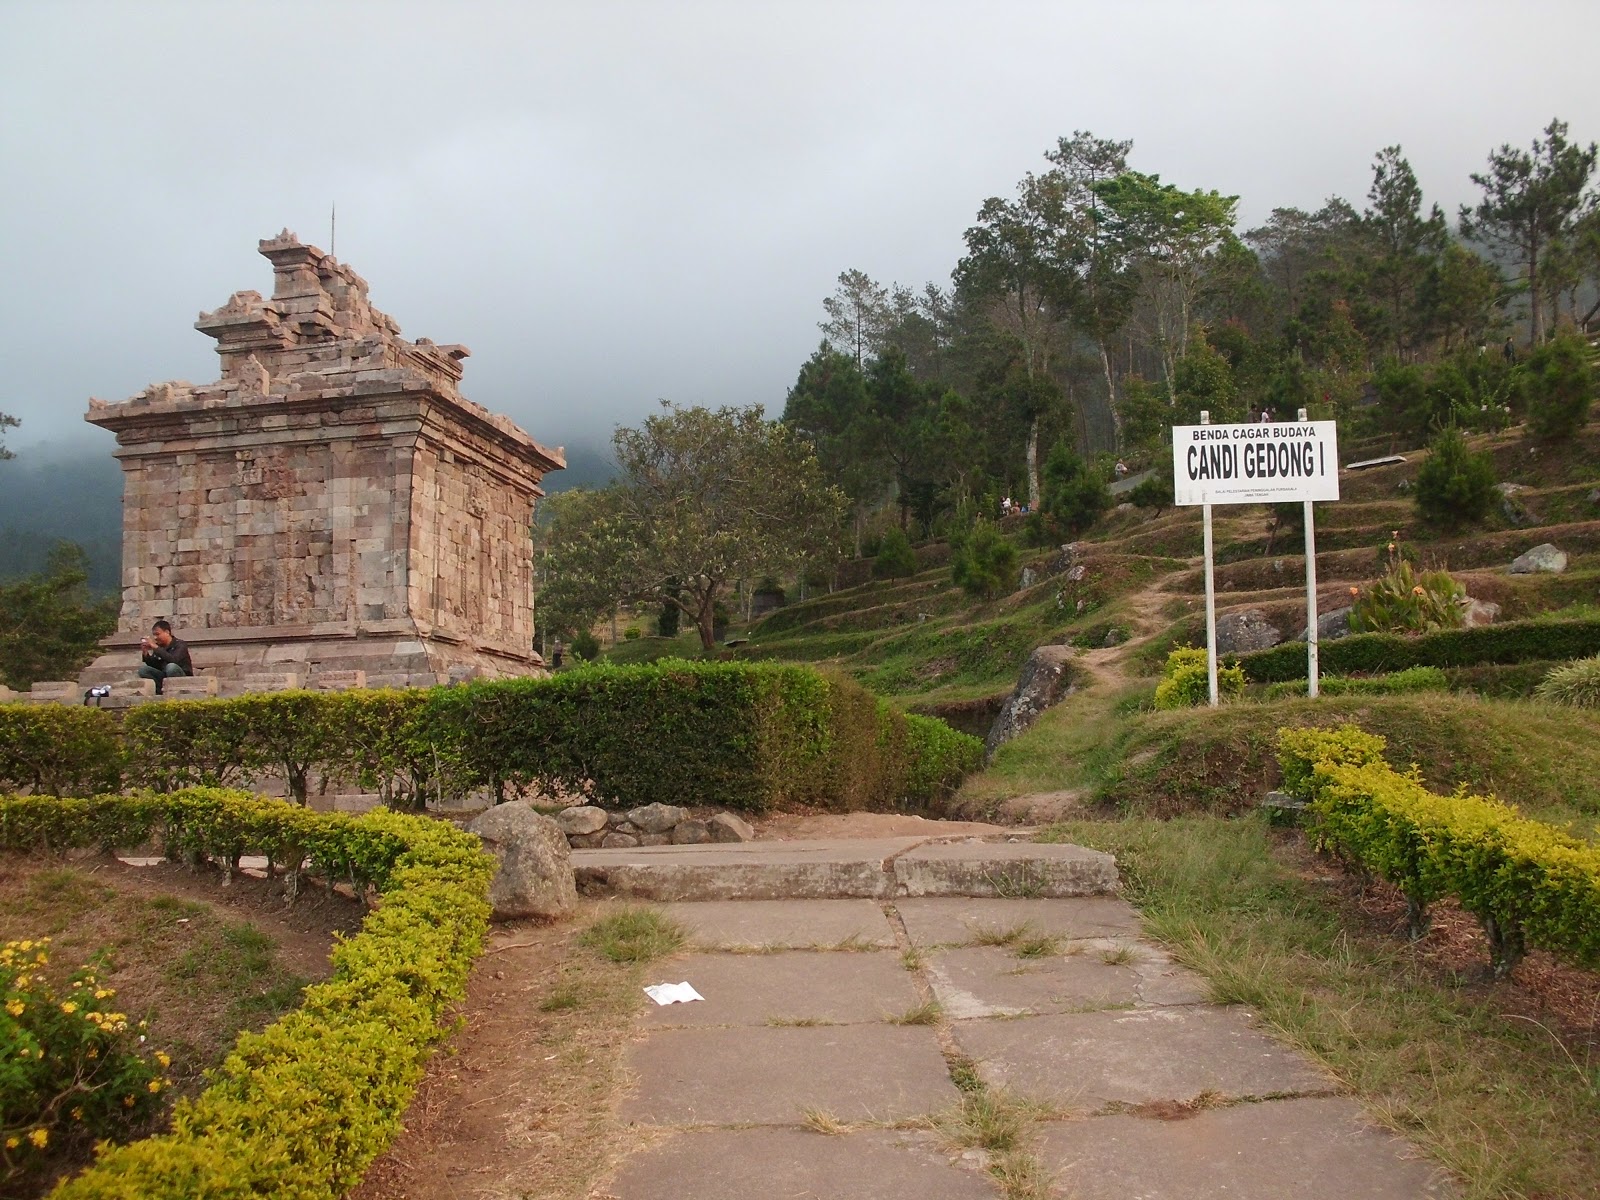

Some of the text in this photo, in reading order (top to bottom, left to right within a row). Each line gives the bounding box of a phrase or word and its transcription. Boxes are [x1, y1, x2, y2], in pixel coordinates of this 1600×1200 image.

[1193, 427, 1316, 440] BENDA CAGAR BUDAYA
[1187, 441, 1325, 481] CANDI GEDONG I
